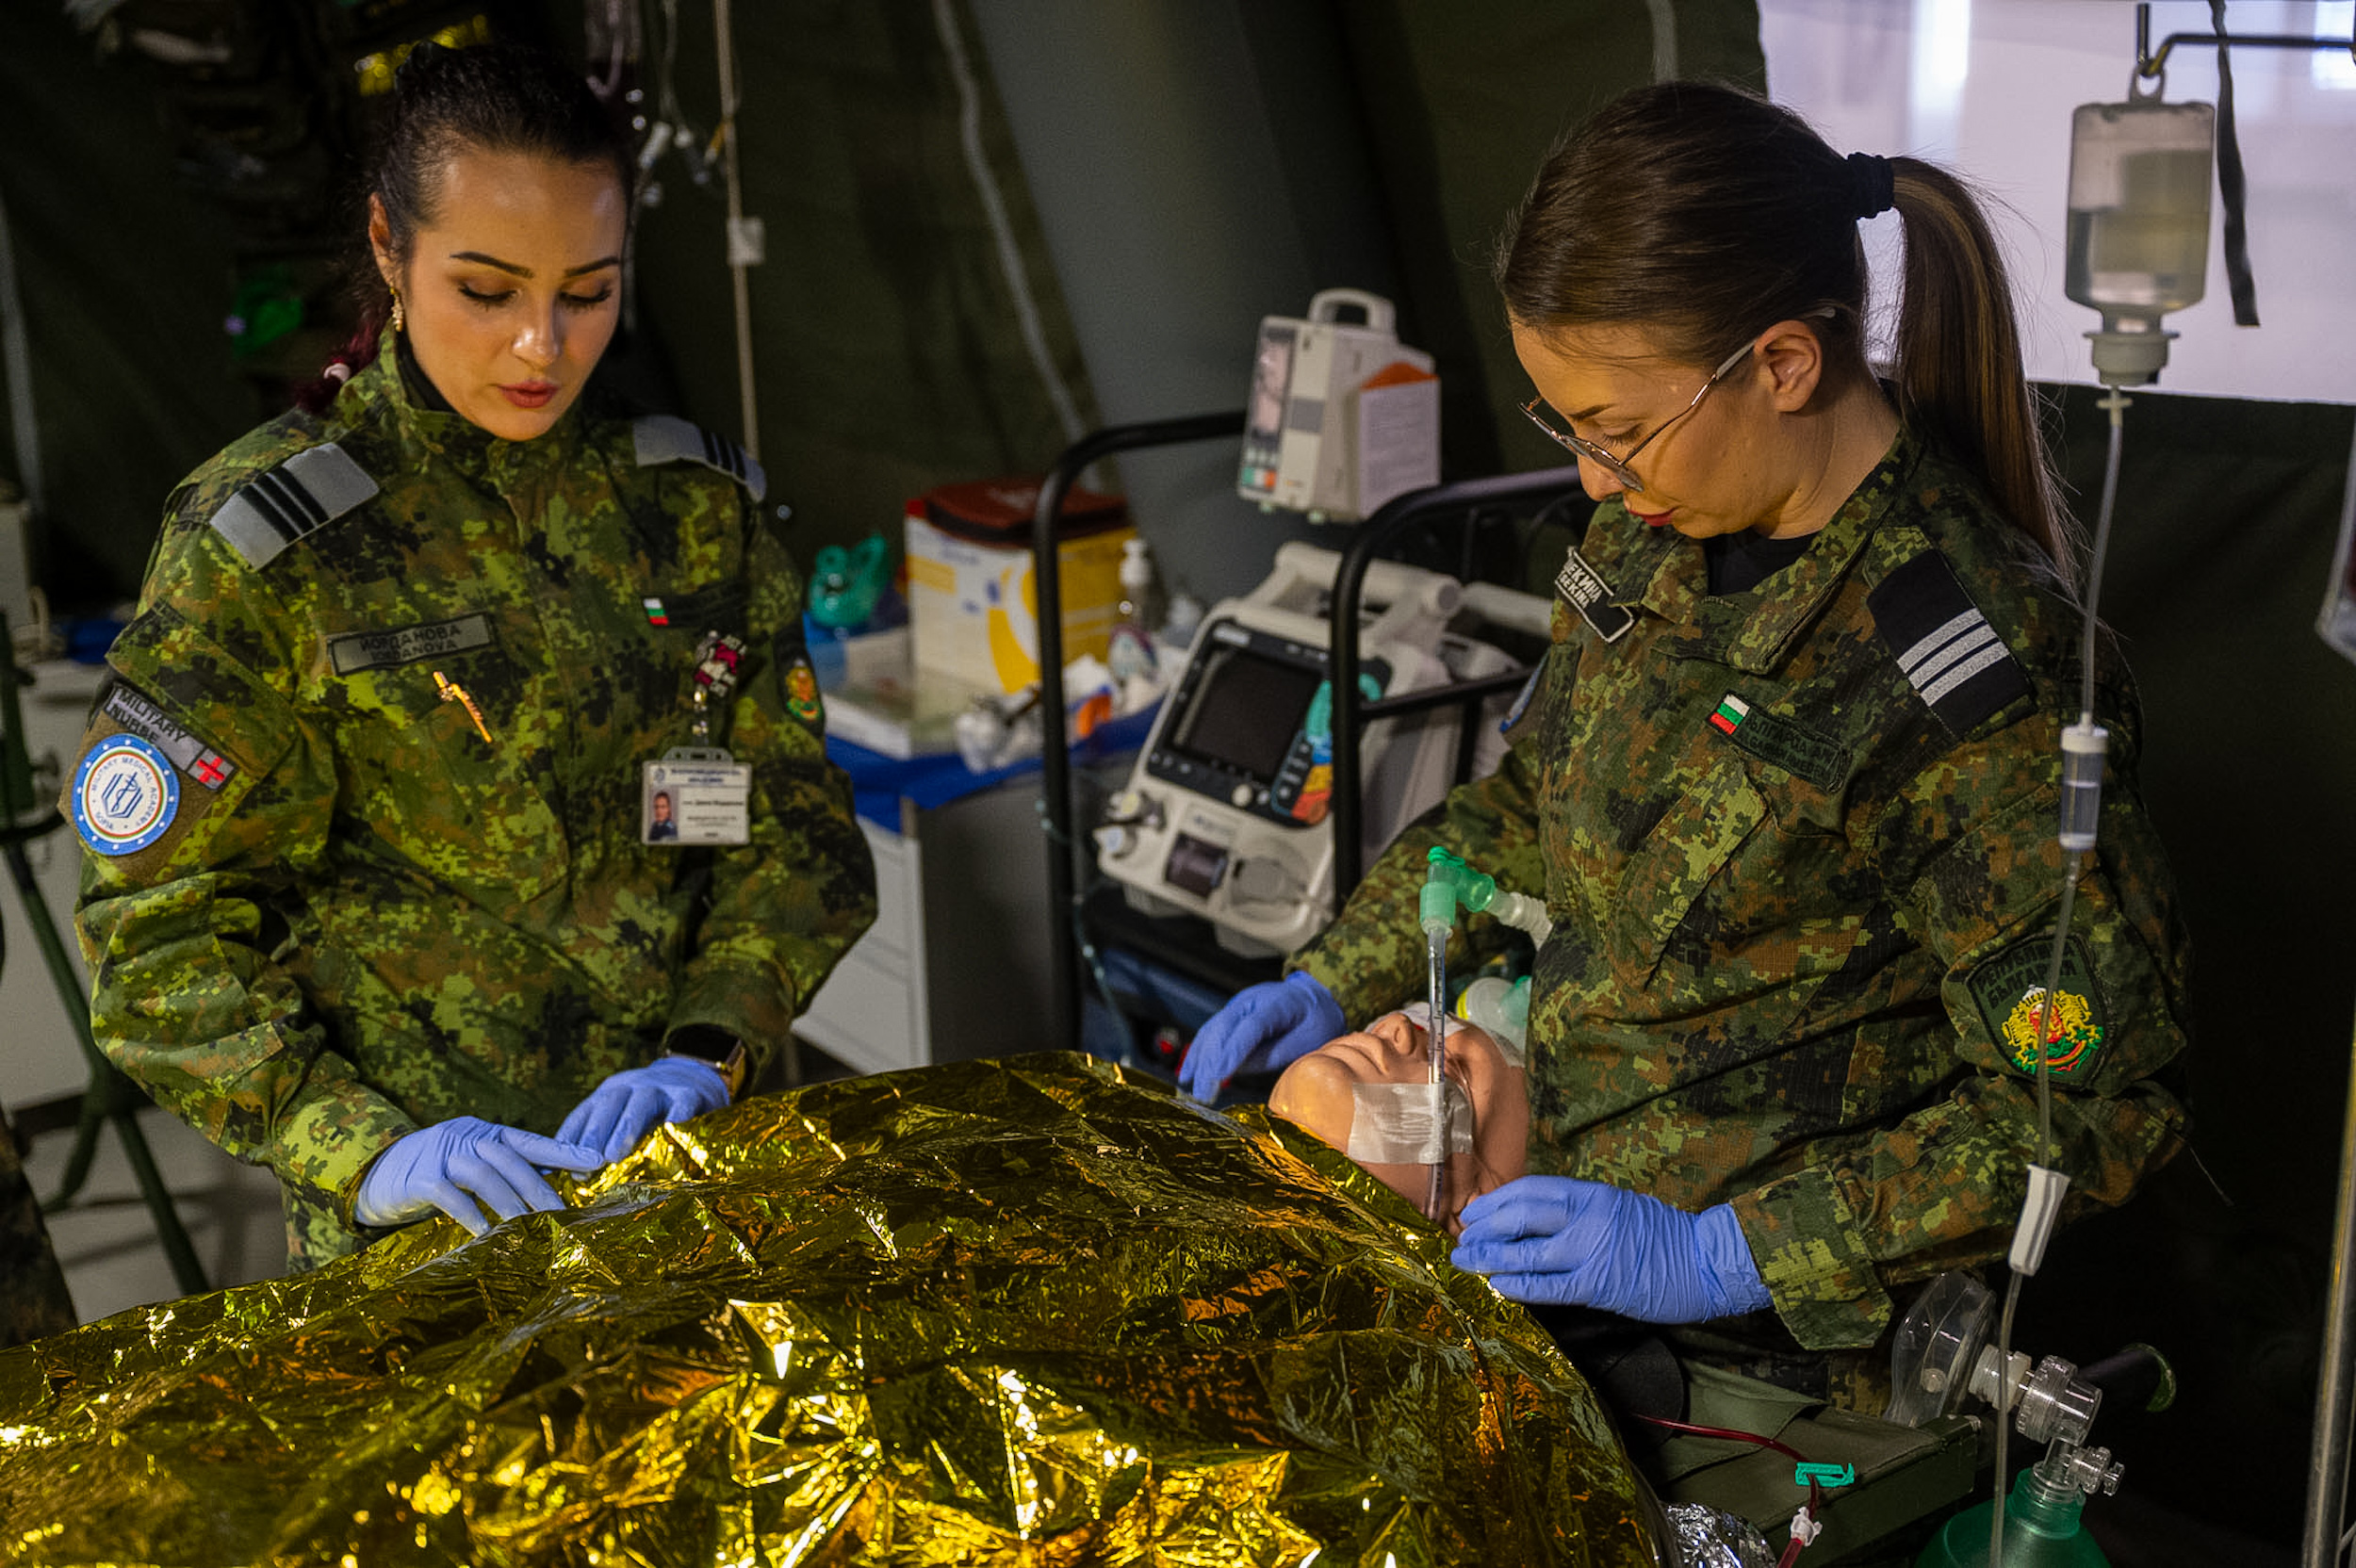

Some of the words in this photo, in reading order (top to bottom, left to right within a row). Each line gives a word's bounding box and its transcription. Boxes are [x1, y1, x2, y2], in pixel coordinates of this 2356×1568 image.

[107, 704, 160, 743] NURSE
[117, 687, 188, 743] MILITARY
[91, 757, 118, 791] MILITARY
[122, 757, 153, 783] MEDICAL
[136, 786, 157, 827] ACADEMY
[1987, 958, 2078, 1009] БЪЛГАРЯ
